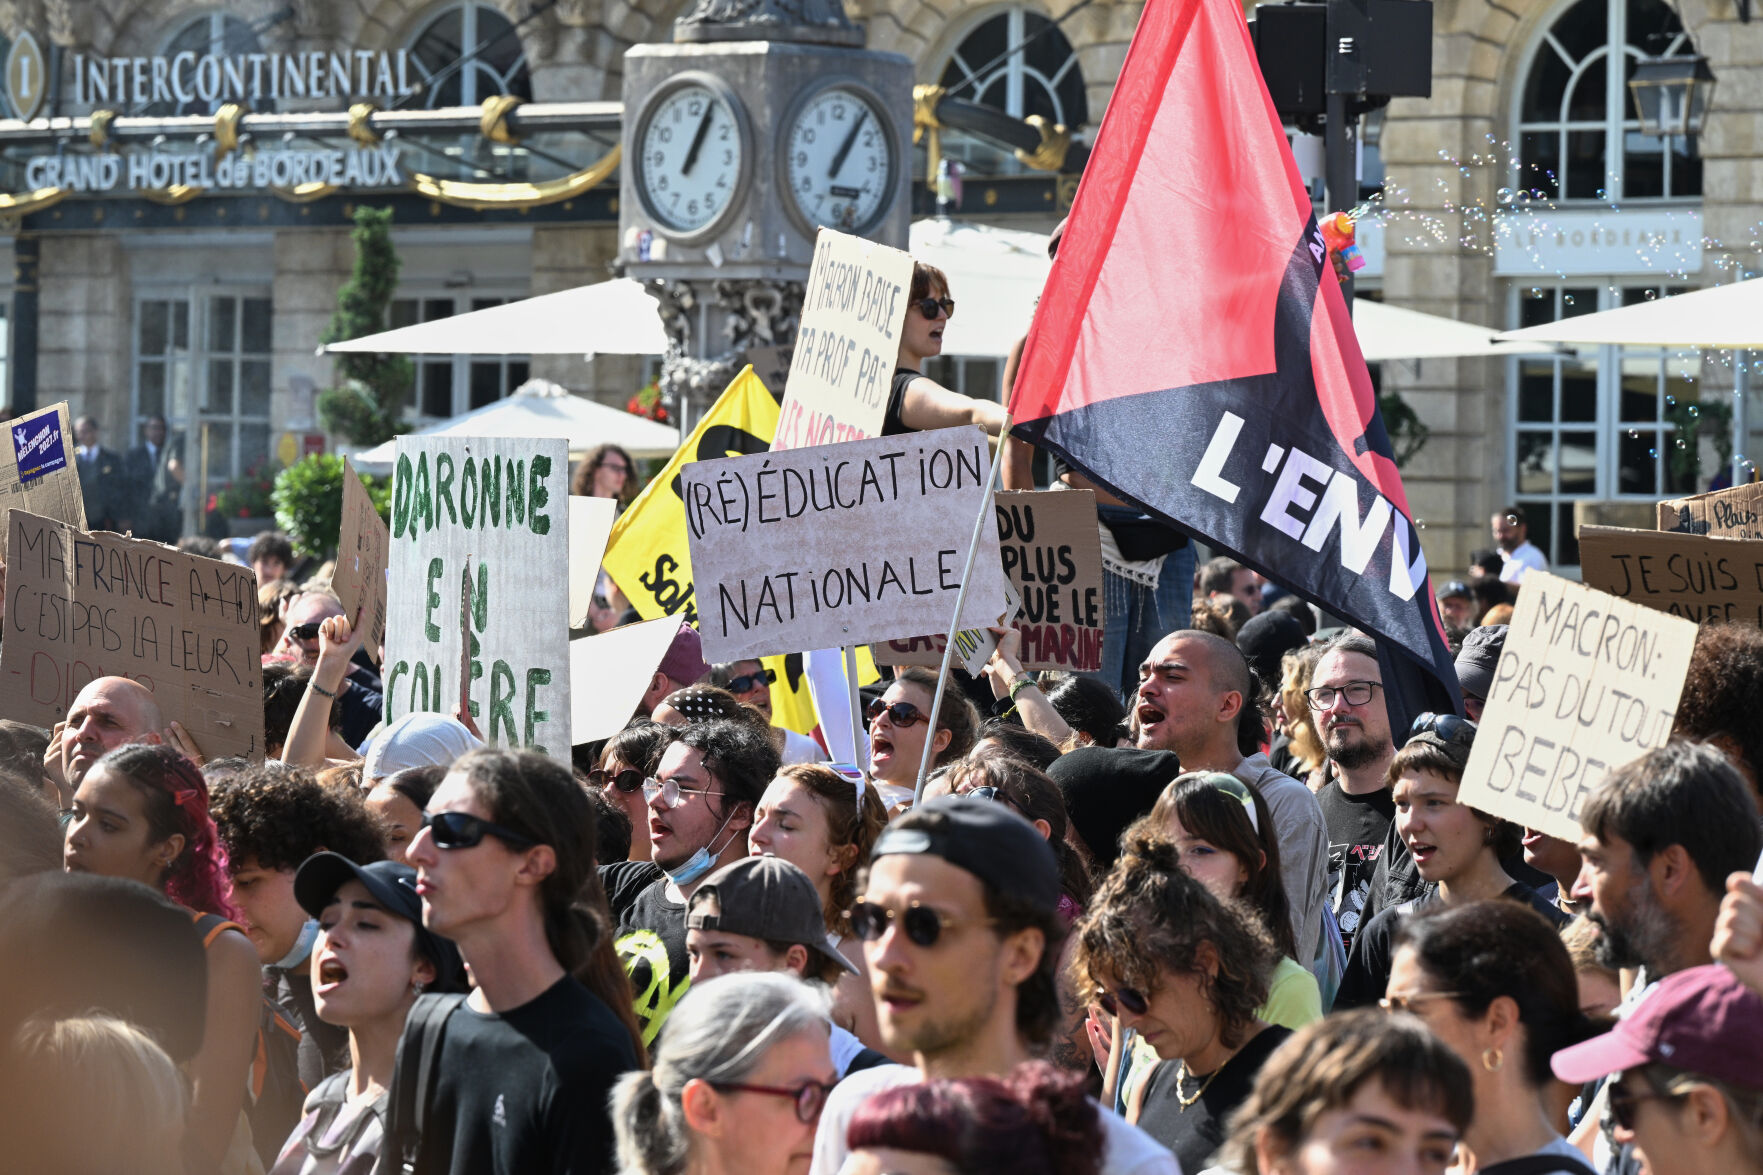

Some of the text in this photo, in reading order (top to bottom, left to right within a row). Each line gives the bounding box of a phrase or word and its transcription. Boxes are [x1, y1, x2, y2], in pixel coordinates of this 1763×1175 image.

[25, 148, 402, 192] GRAND HOTEL de BORDEAUX
[796, 327, 817, 375] TA
[813, 330, 856, 389] PROF
[854, 347, 887, 410] PAS
[19, 522, 65, 582] MA
[73, 540, 174, 608] FRANCE
[1000, 545, 1075, 585] PLUS
[1014, 584, 1097, 627] UE LE
[133, 616, 159, 662] LA
[1491, 651, 1676, 749] PAS DU TOUT
